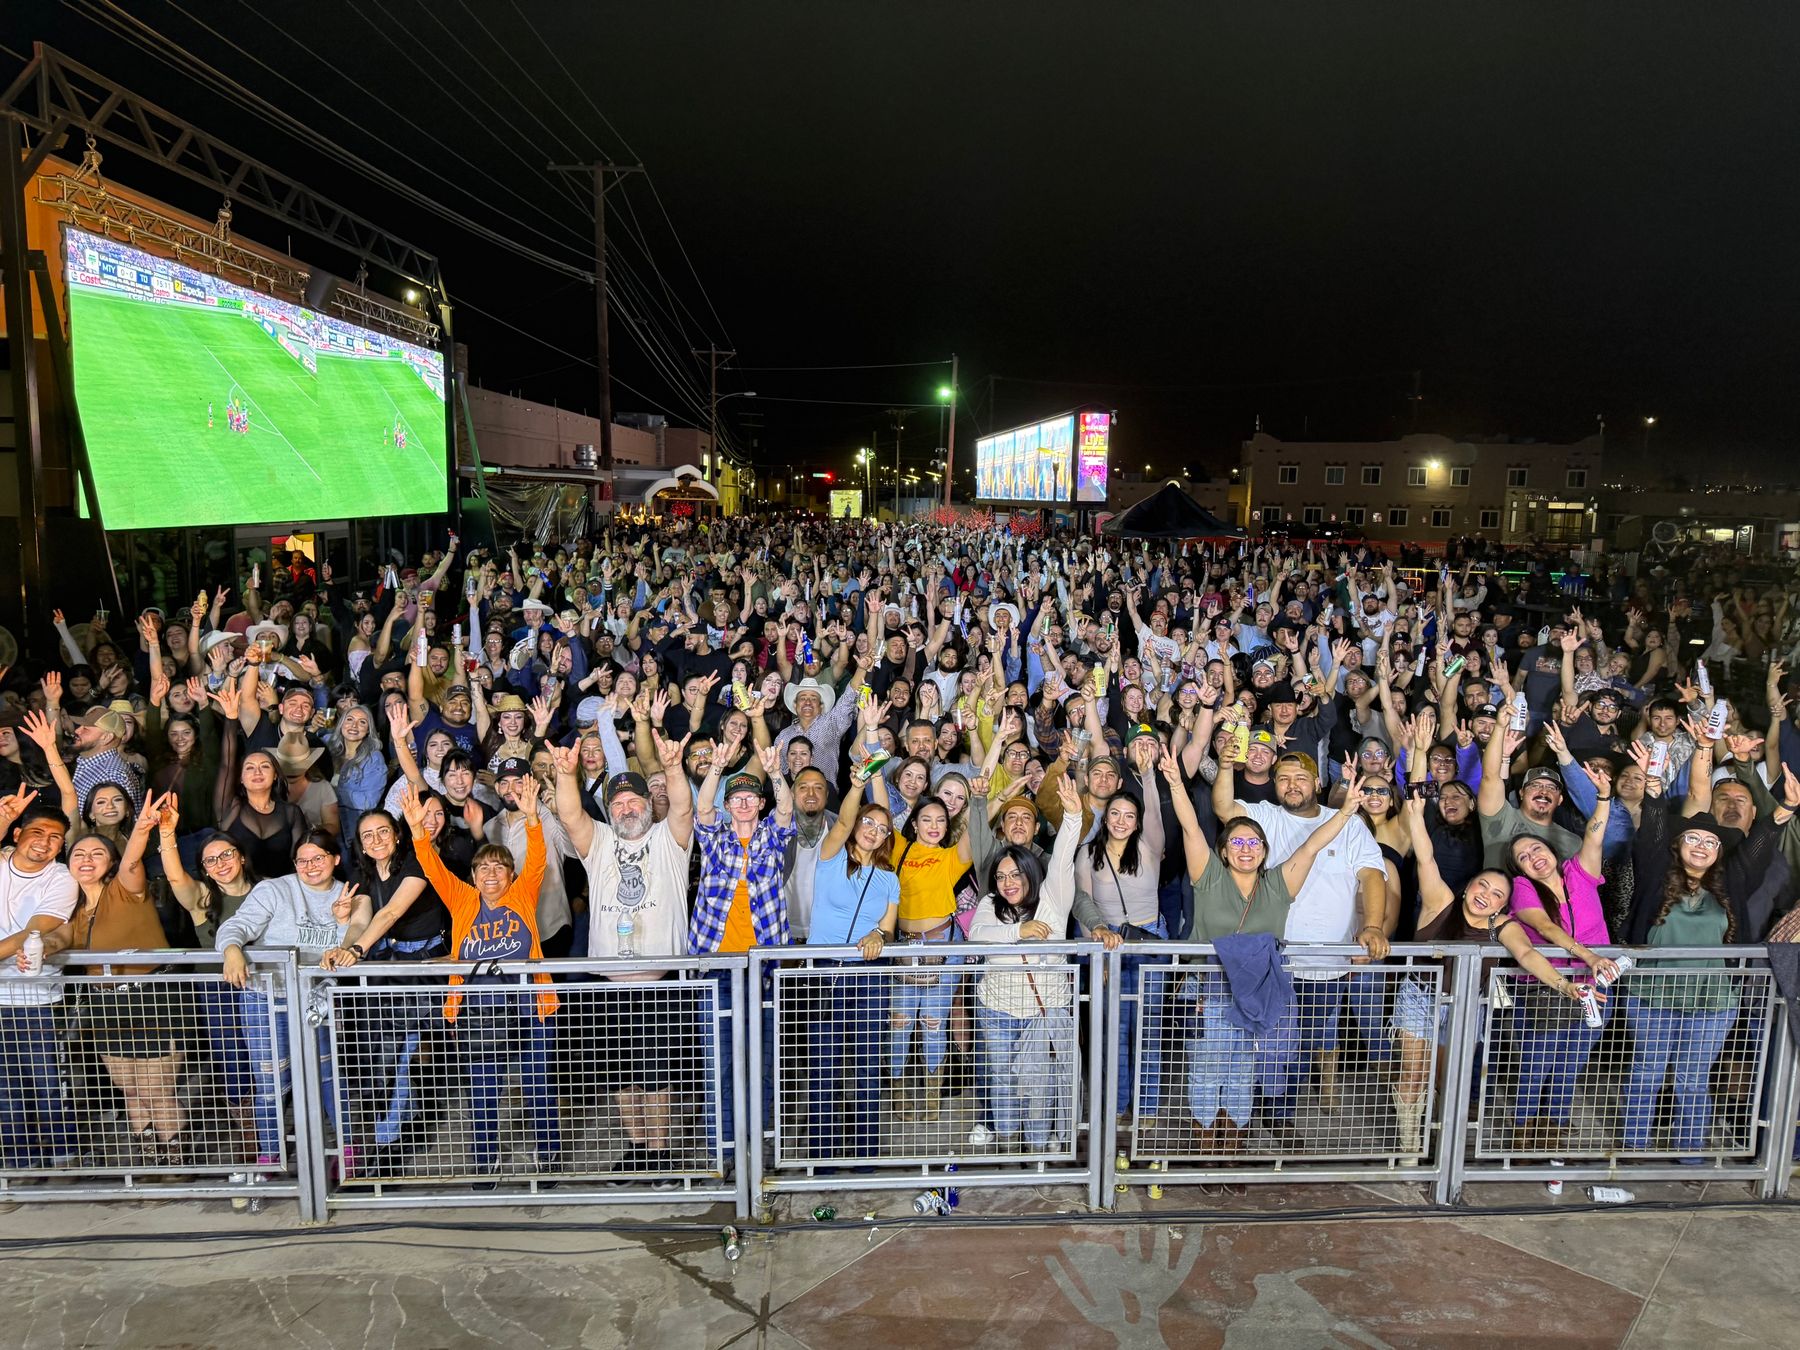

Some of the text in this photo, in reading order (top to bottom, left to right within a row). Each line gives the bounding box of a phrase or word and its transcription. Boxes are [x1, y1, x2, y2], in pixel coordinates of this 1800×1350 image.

[181, 281, 205, 298] Expedia
[296, 928, 329, 945] NEWPORT
[467, 919, 521, 942] UTEP
